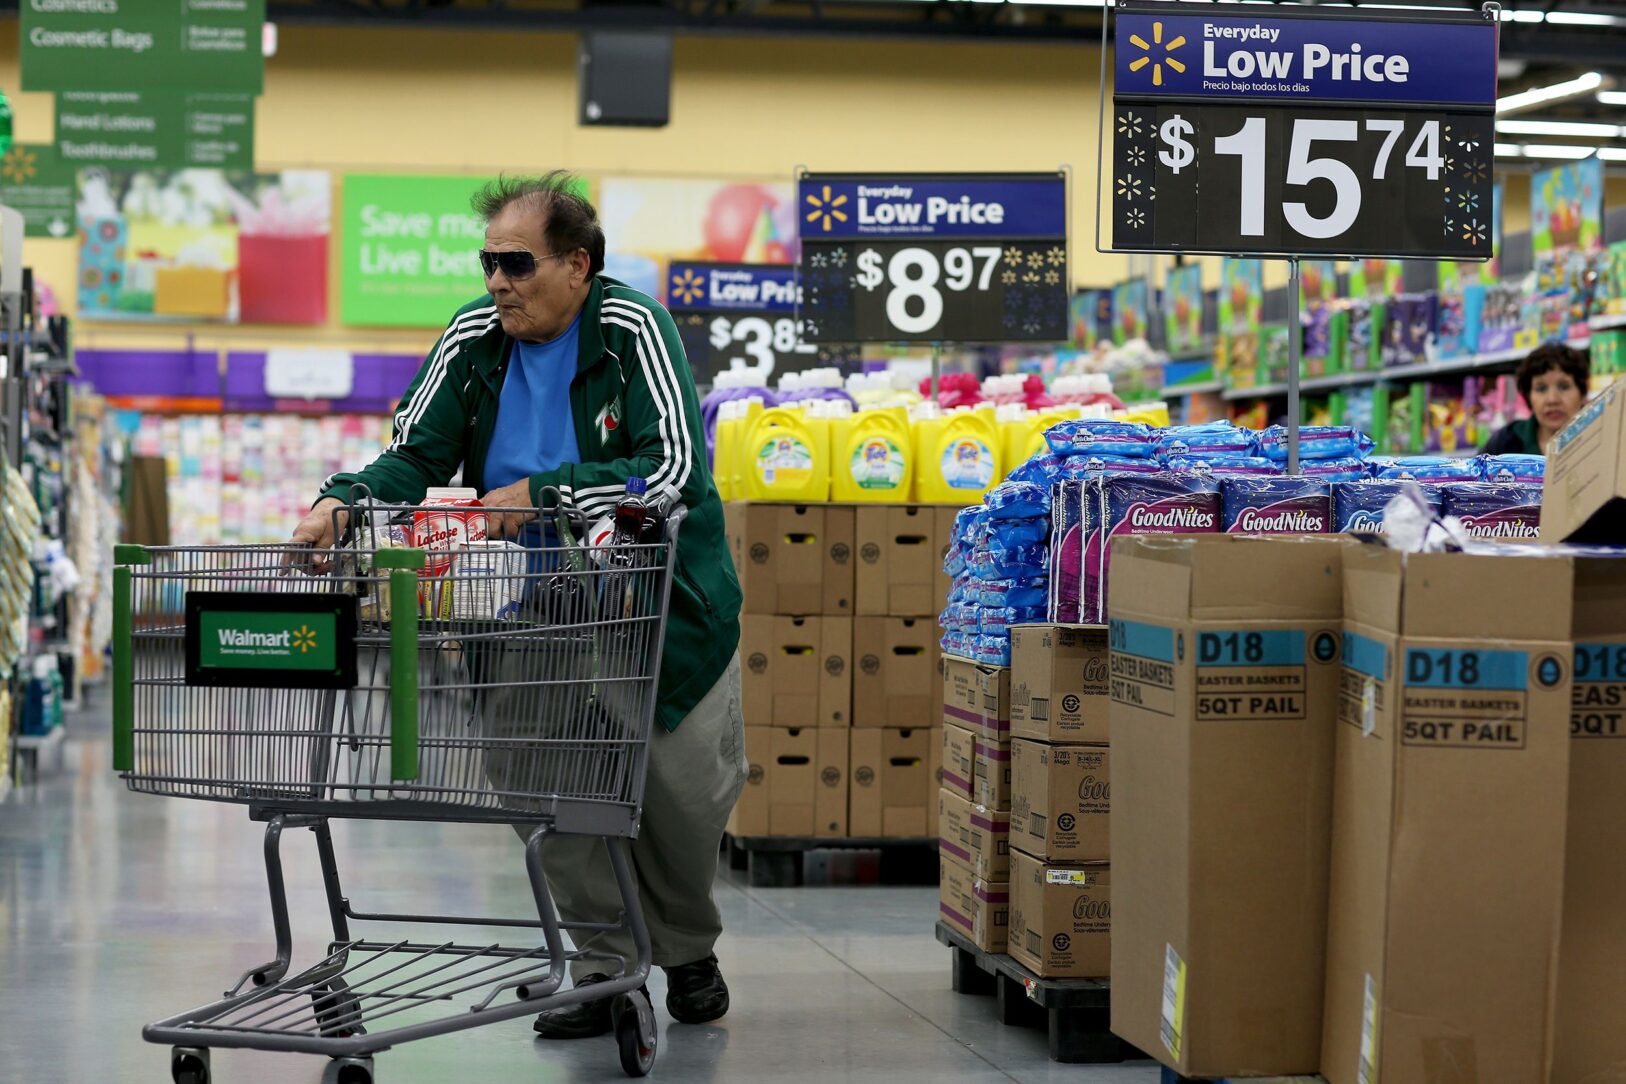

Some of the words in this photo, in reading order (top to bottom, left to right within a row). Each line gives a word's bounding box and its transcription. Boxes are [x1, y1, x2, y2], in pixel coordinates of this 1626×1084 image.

[30, 27, 109, 48] Cosmetic
[111, 28, 153, 53] Bags
[1203, 23, 1280, 43] Everyday
[1203, 41, 1294, 79] Low
[1303, 42, 1410, 83] Price
[1203, 81, 1230, 91] Precio
[1231, 82, 1251, 92] bajo
[1252, 82, 1277, 92] todos
[1278, 83, 1291, 92] los
[1159, 115, 1195, 175] $
[857, 185, 913, 200] Everyday
[857, 197, 922, 225] Low
[926, 195, 1005, 225] Price
[360, 204, 430, 239] Save
[438, 212, 486, 240] mo
[360, 241, 421, 275] Live
[857, 248, 884, 291] $
[709, 279, 760, 303] Low
[1131, 507, 1214, 528] GoodNites
[1242, 511, 1323, 532] GoodNites
[417, 528, 458, 547] Lactose
[217, 628, 290, 647] Walmart
[1200, 633, 1265, 663] D18
[1110, 656, 1139, 678] EASTER
[1138, 661, 1174, 687] BASKETS
[1408, 651, 1480, 685] D18
[1198, 675, 1244, 686] EASTER
[1246, 675, 1301, 686] BASKETS
[1111, 680, 1128, 700] 5QT
[1126, 682, 1144, 705] PAIL
[1572, 684, 1626, 706] EAS
[1199, 699, 1242, 715] 5QT
[1249, 698, 1300, 714] PAIL
[1405, 697, 1456, 709] EASTER
[1459, 698, 1521, 711] BASKETS
[1405, 721, 1454, 741] 5QT
[1461, 723, 1519, 742] PAIL
[1570, 713, 1622, 735] 5QT
